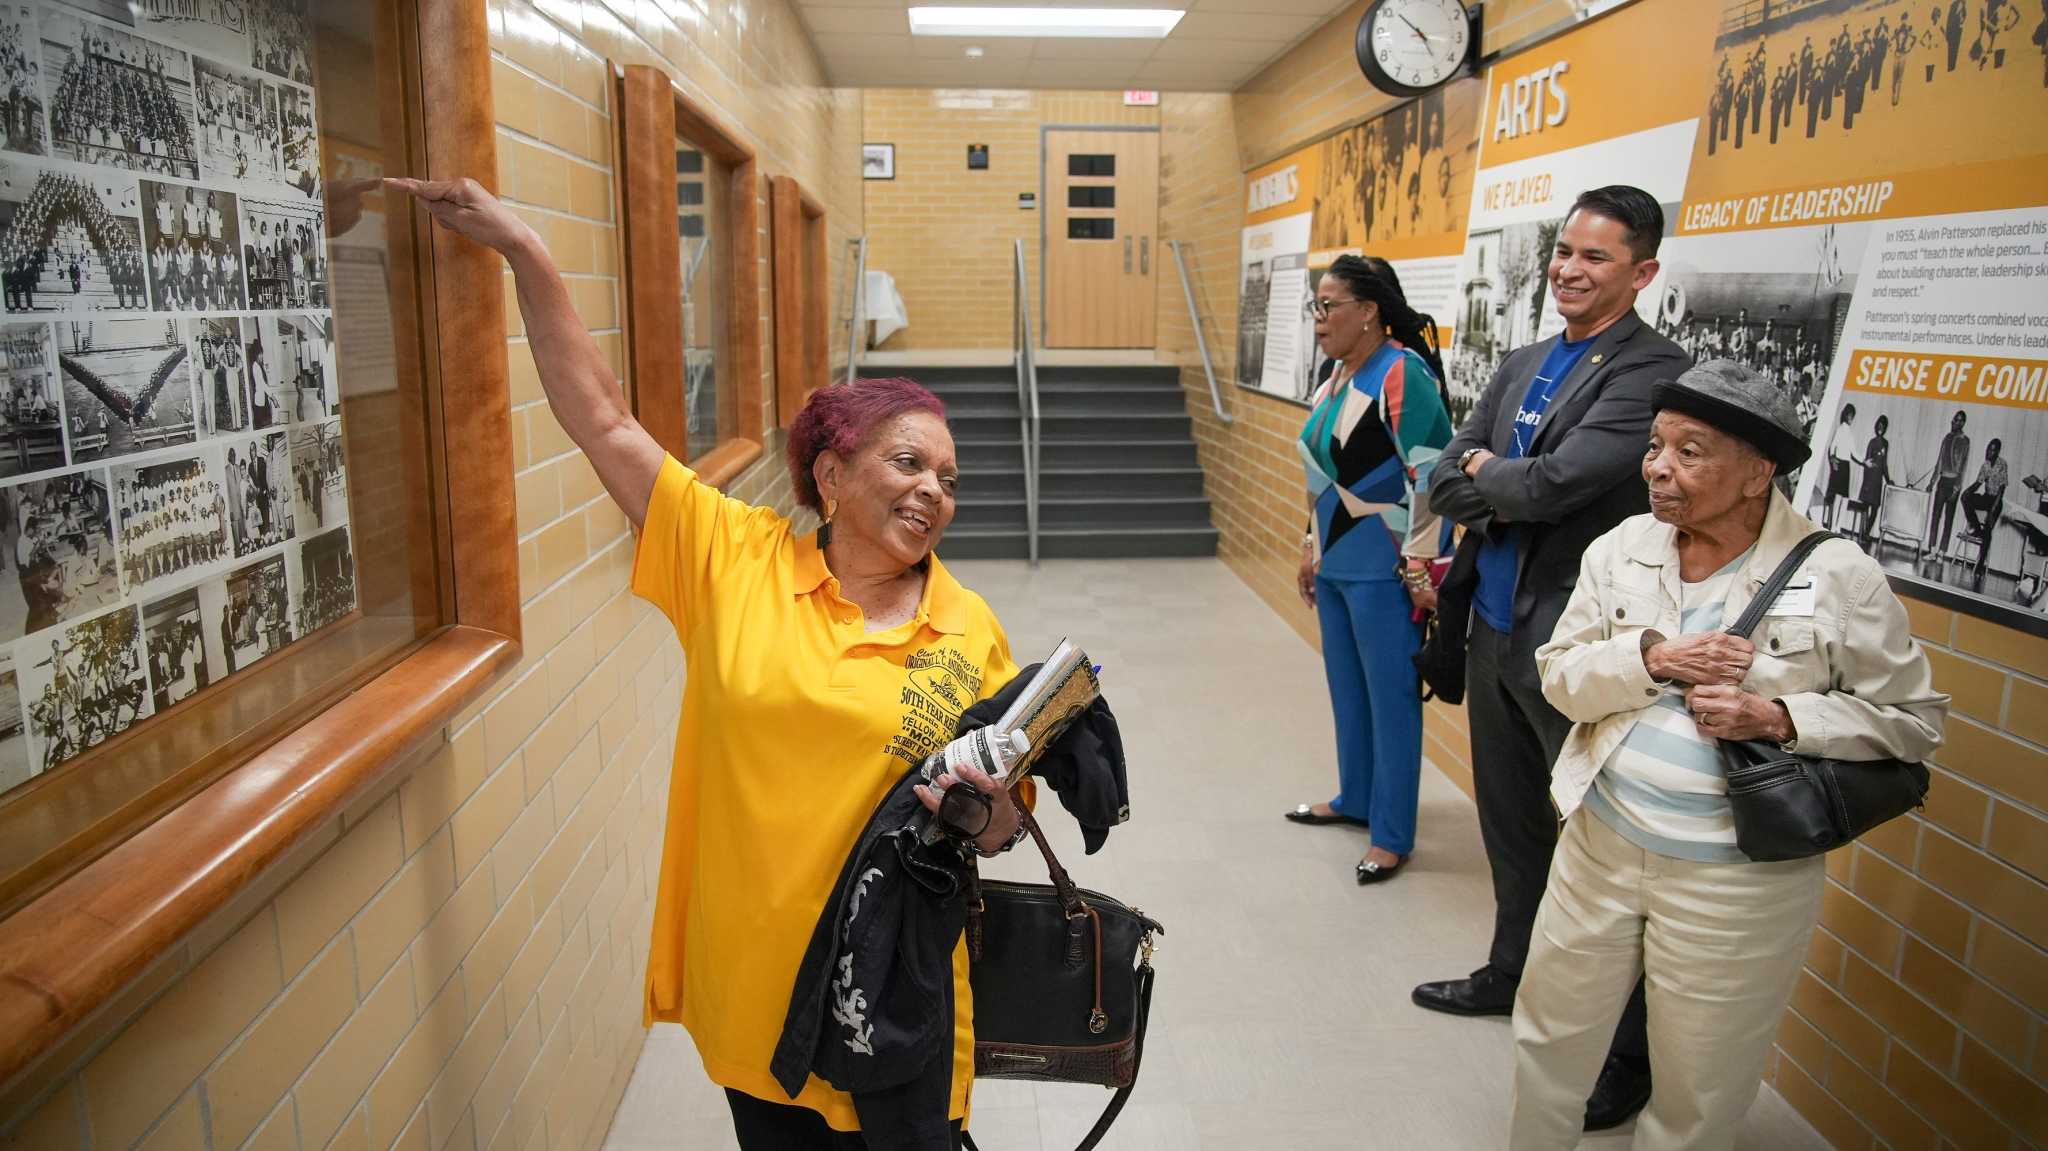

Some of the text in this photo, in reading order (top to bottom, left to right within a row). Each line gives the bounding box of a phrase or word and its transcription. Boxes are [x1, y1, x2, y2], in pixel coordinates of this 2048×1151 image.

[1382, 8, 1393, 18] 10
[1454, 9, 1461, 20] 2
[1457, 31, 1463, 44] 3
[1381, 49, 1388, 62] 8
[1448, 53, 1455, 62] 4
[1395, 66, 1402, 77] 7
[1412, 73, 1421, 84] 6
[1434, 66, 1441, 79] 5
[1494, 60, 1570, 143] ARTS
[1483, 174, 1553, 212] WE PLAYED.
[1684, 181, 1893, 231] LEGACY OF LEADERSHIP
[1886, 220, 2048, 243] In 1955, Alvin Patterson replaced his
[1881, 253, 1897, 263] you
[1896, 250, 1918, 260] must
[1949, 247, 1966, 258] the
[1966, 244, 1995, 257] whole
[1876, 268, 1900, 280] about
[1901, 266, 1935, 280] building
[1935, 265, 1980, 279] character,
[1981, 263, 2033, 278] leadership
[1872, 286, 1888, 297] and
[1911, 313, 1936, 326] spring
[1938, 313, 1976, 325] concerts
[1977, 313, 2026, 326] combined
[1861, 329, 1911, 341] instrumental
[1912, 331, 1975, 344] performances.
[1976, 332, 2006, 346] Under
[2007, 334, 2021, 347] his
[1856, 355, 1934, 391] SENSE
[1937, 361, 1974, 395] OF
[905, 654, 935, 670] ORIGINAL
[925, 700, 944, 724] YEAR
[902, 715, 937, 739] YELLOW
[883, 744, 891, 754] IS
